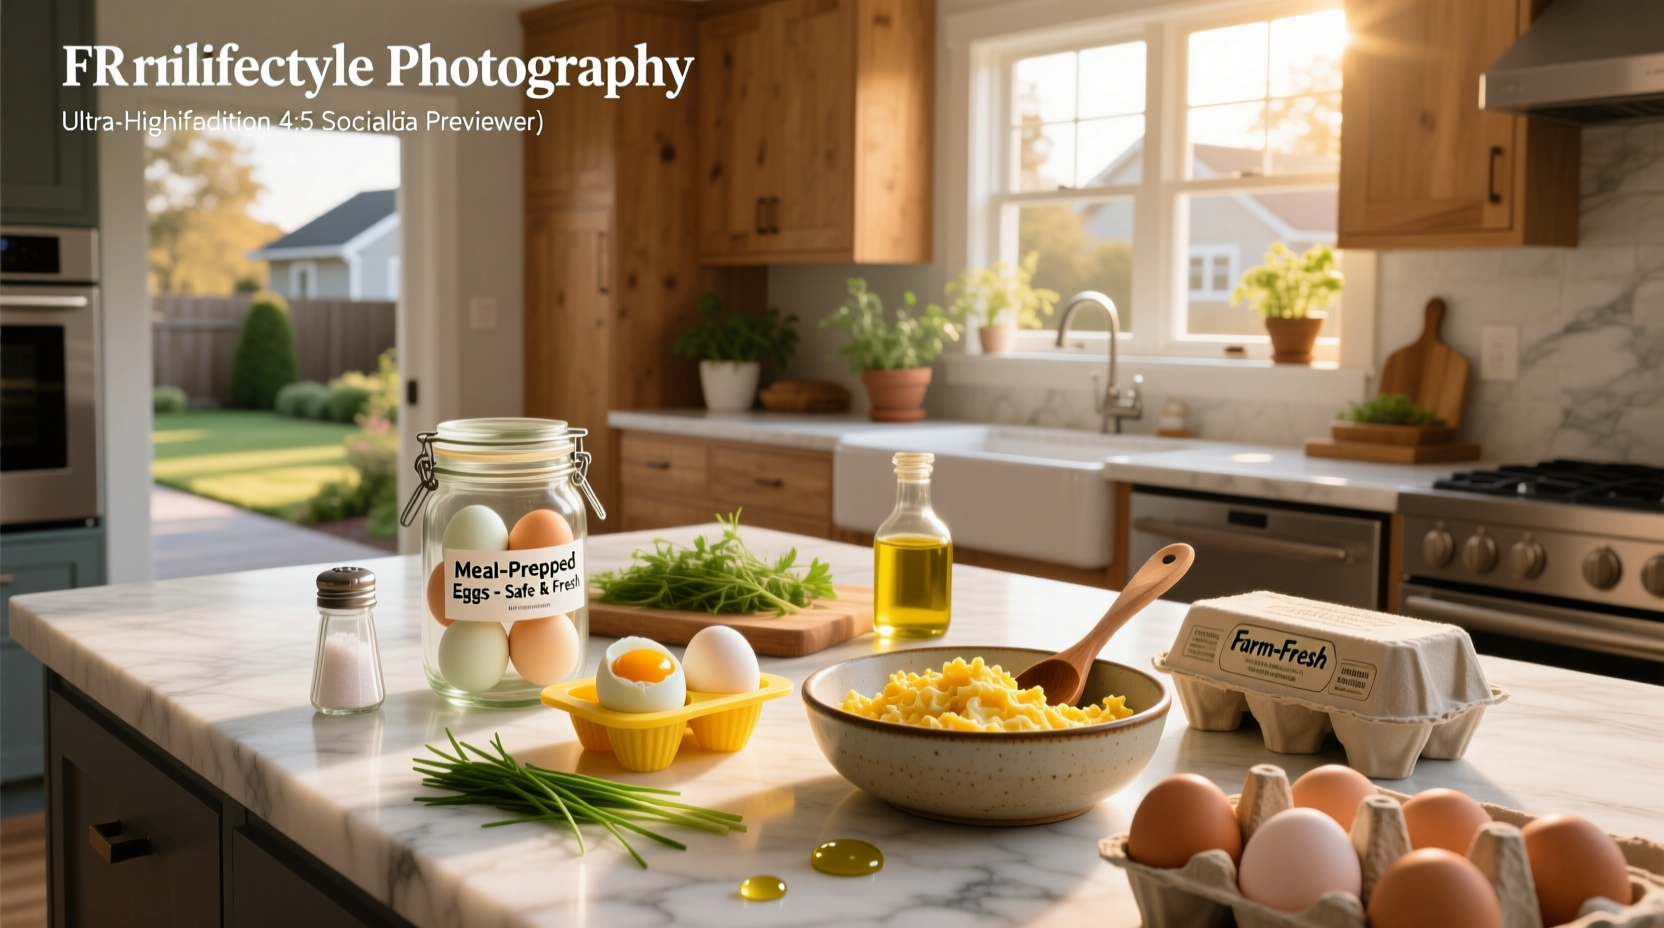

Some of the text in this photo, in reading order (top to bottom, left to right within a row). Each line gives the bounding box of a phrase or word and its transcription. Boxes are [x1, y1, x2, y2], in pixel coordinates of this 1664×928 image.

[455, 551, 576, 579] Meal-Prepped
[453, 583, 490, 605] Eggs
[505, 583, 536, 599] Safe
[540, 581, 550, 596] &
[553, 574, 581, 593] Fresh
[1230, 630, 1328, 669] Farm-Fresh
